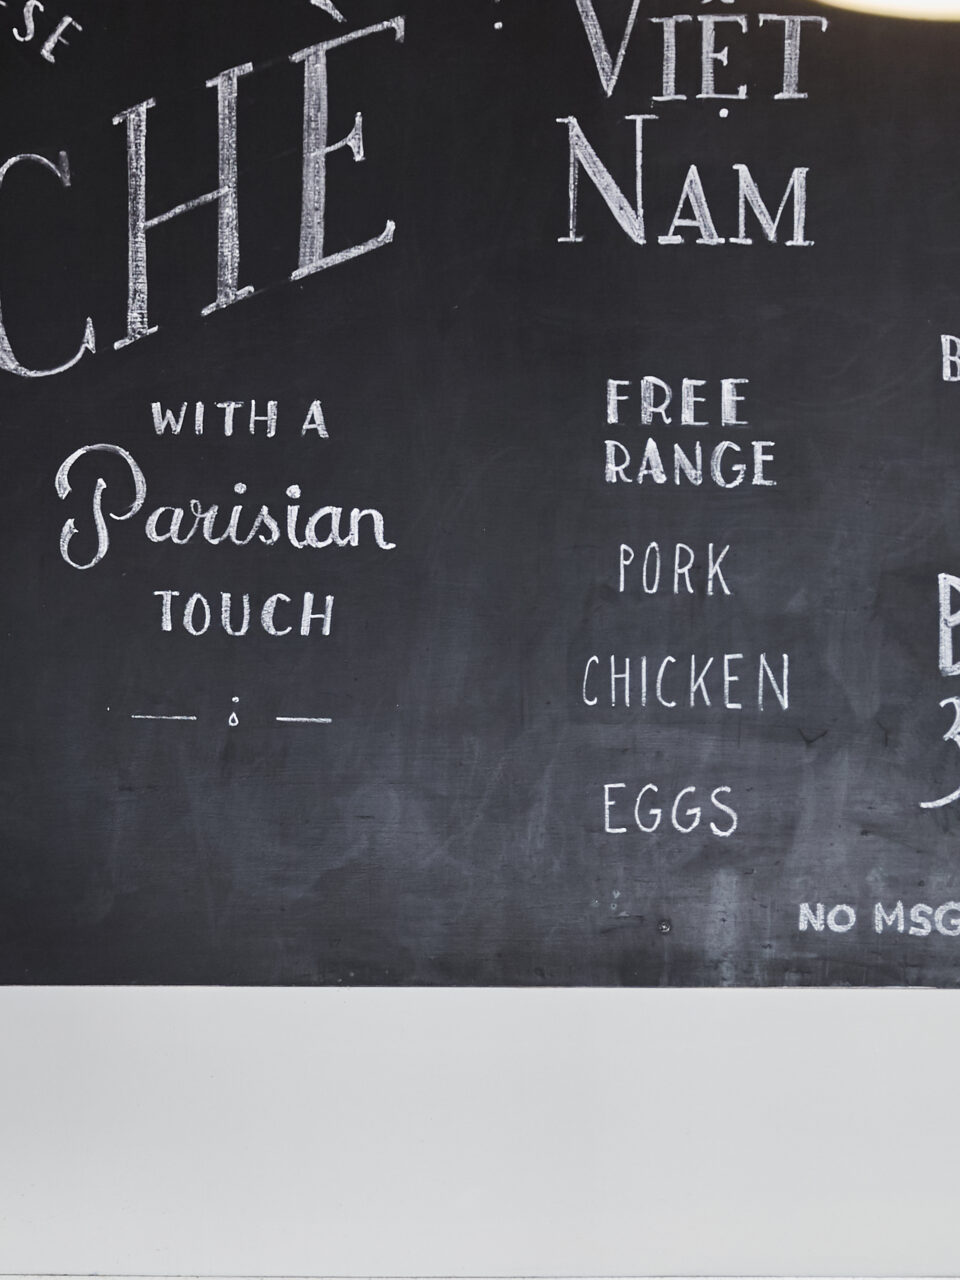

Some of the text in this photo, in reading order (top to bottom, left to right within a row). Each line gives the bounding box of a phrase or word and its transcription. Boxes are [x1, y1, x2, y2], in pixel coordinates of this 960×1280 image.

[556, 115, 815, 246] NAM
[151, 400, 329, 438] WITH A
[606, 376, 750, 426] FREE
[604, 438, 777, 488] RANGE
[55, 443, 396, 570] Parisian
[620, 541, 731, 595] PORK
[153, 591, 334, 636] TOUCH
[582, 653, 789, 711] CHICKEN
[604, 783, 738, 837] EGGS
[798, 900, 960, 936] NO MSG
